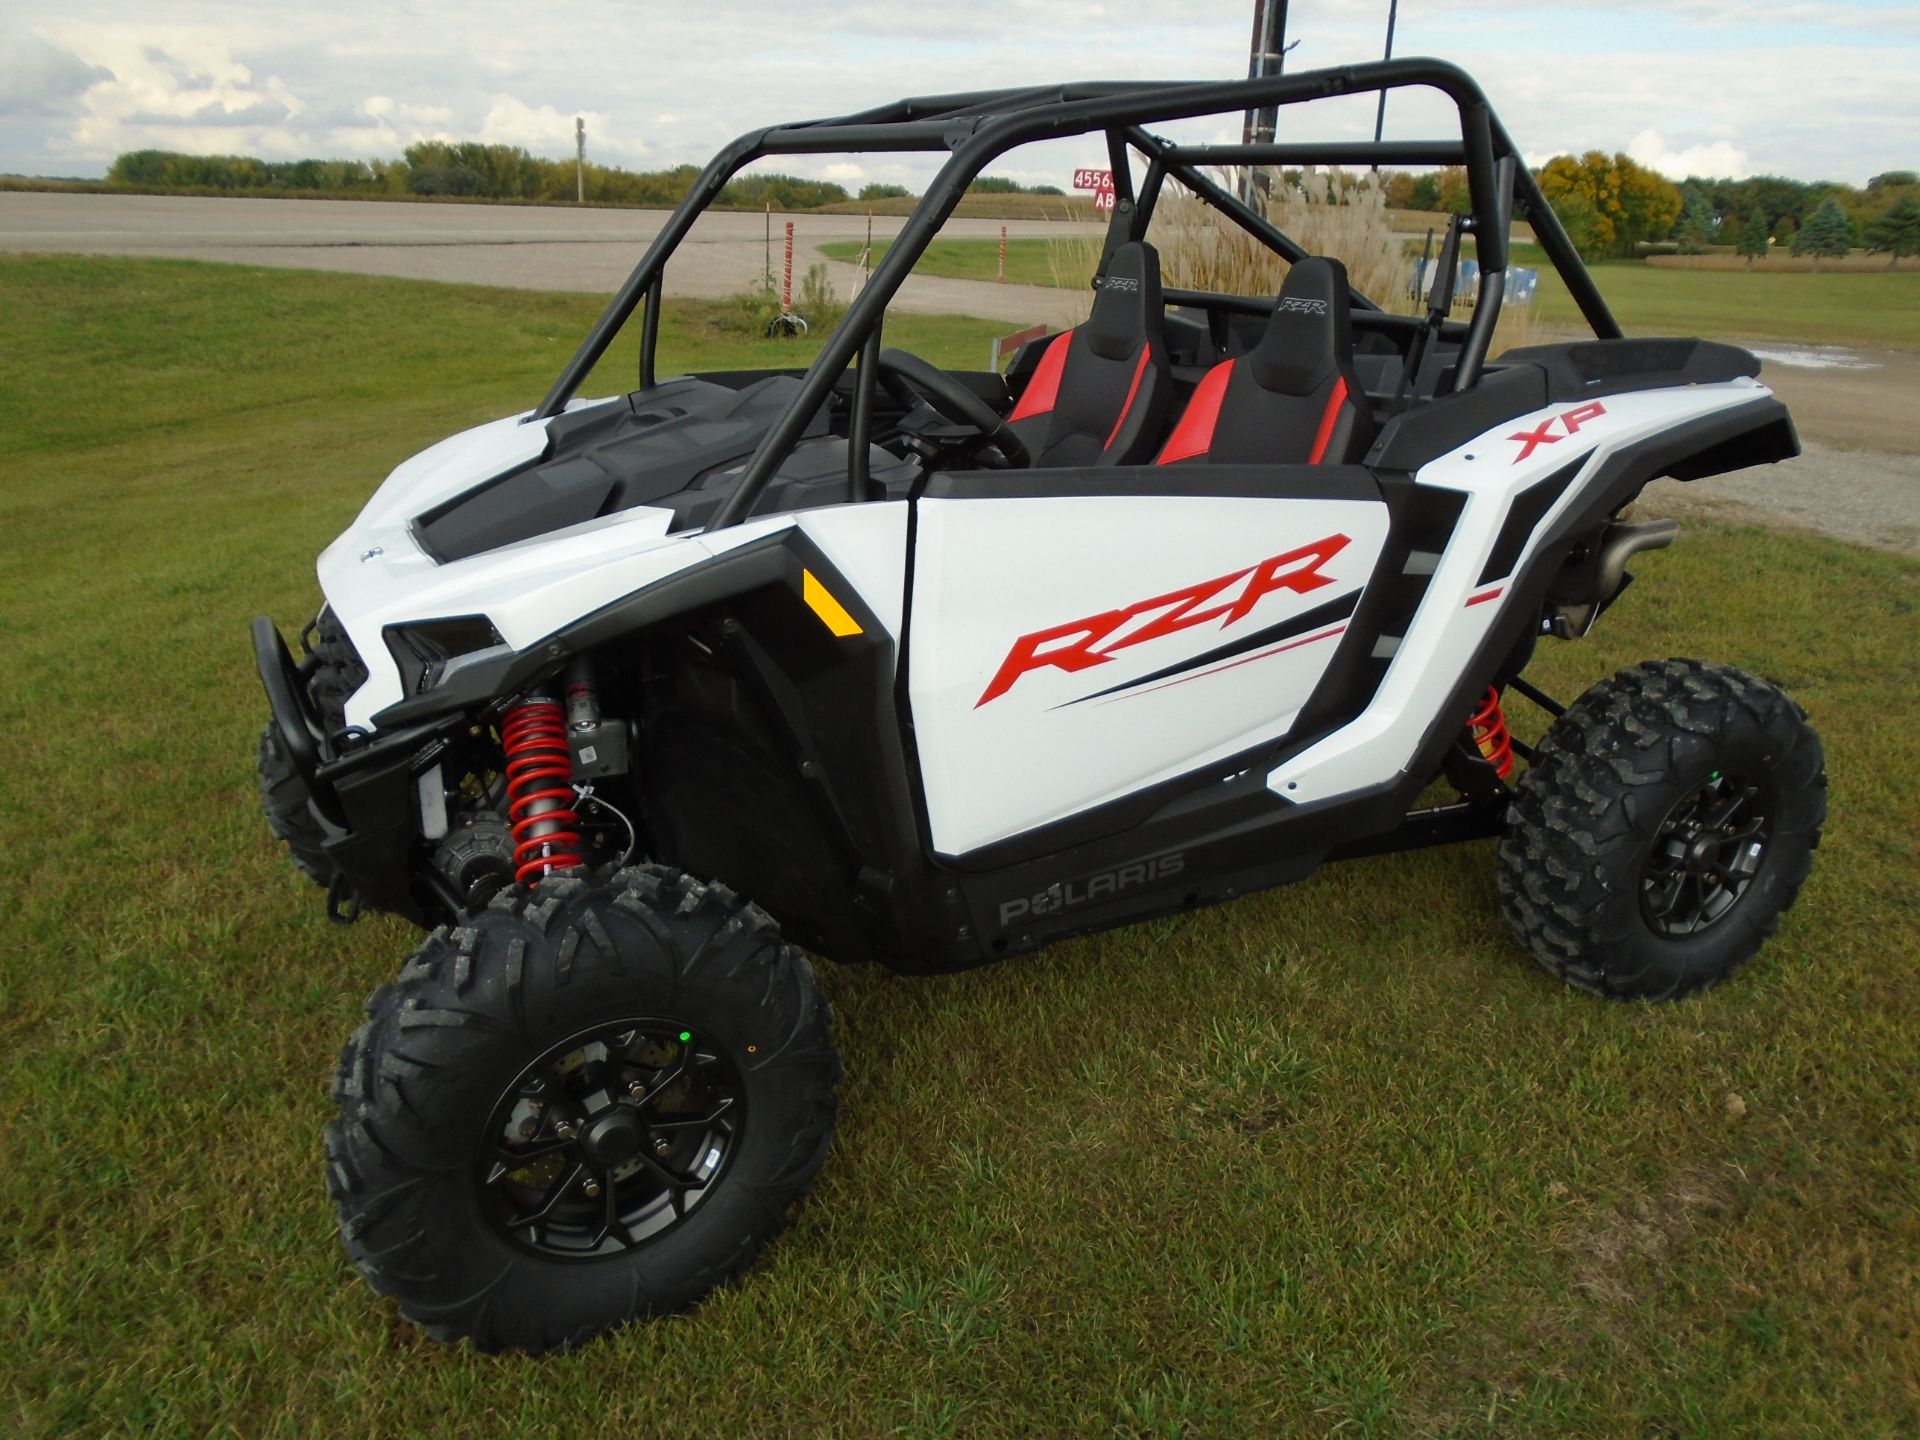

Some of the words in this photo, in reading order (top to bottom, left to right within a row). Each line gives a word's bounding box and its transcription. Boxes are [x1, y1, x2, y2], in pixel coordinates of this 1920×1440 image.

[1074, 171, 1114, 188] 4556
[1105, 276, 1138, 291] RZR
[1278, 296, 1328, 315] RZR
[1505, 401, 1607, 465] XP
[973, 533, 1352, 710] RZR
[999, 852, 1186, 926] POLARIS
